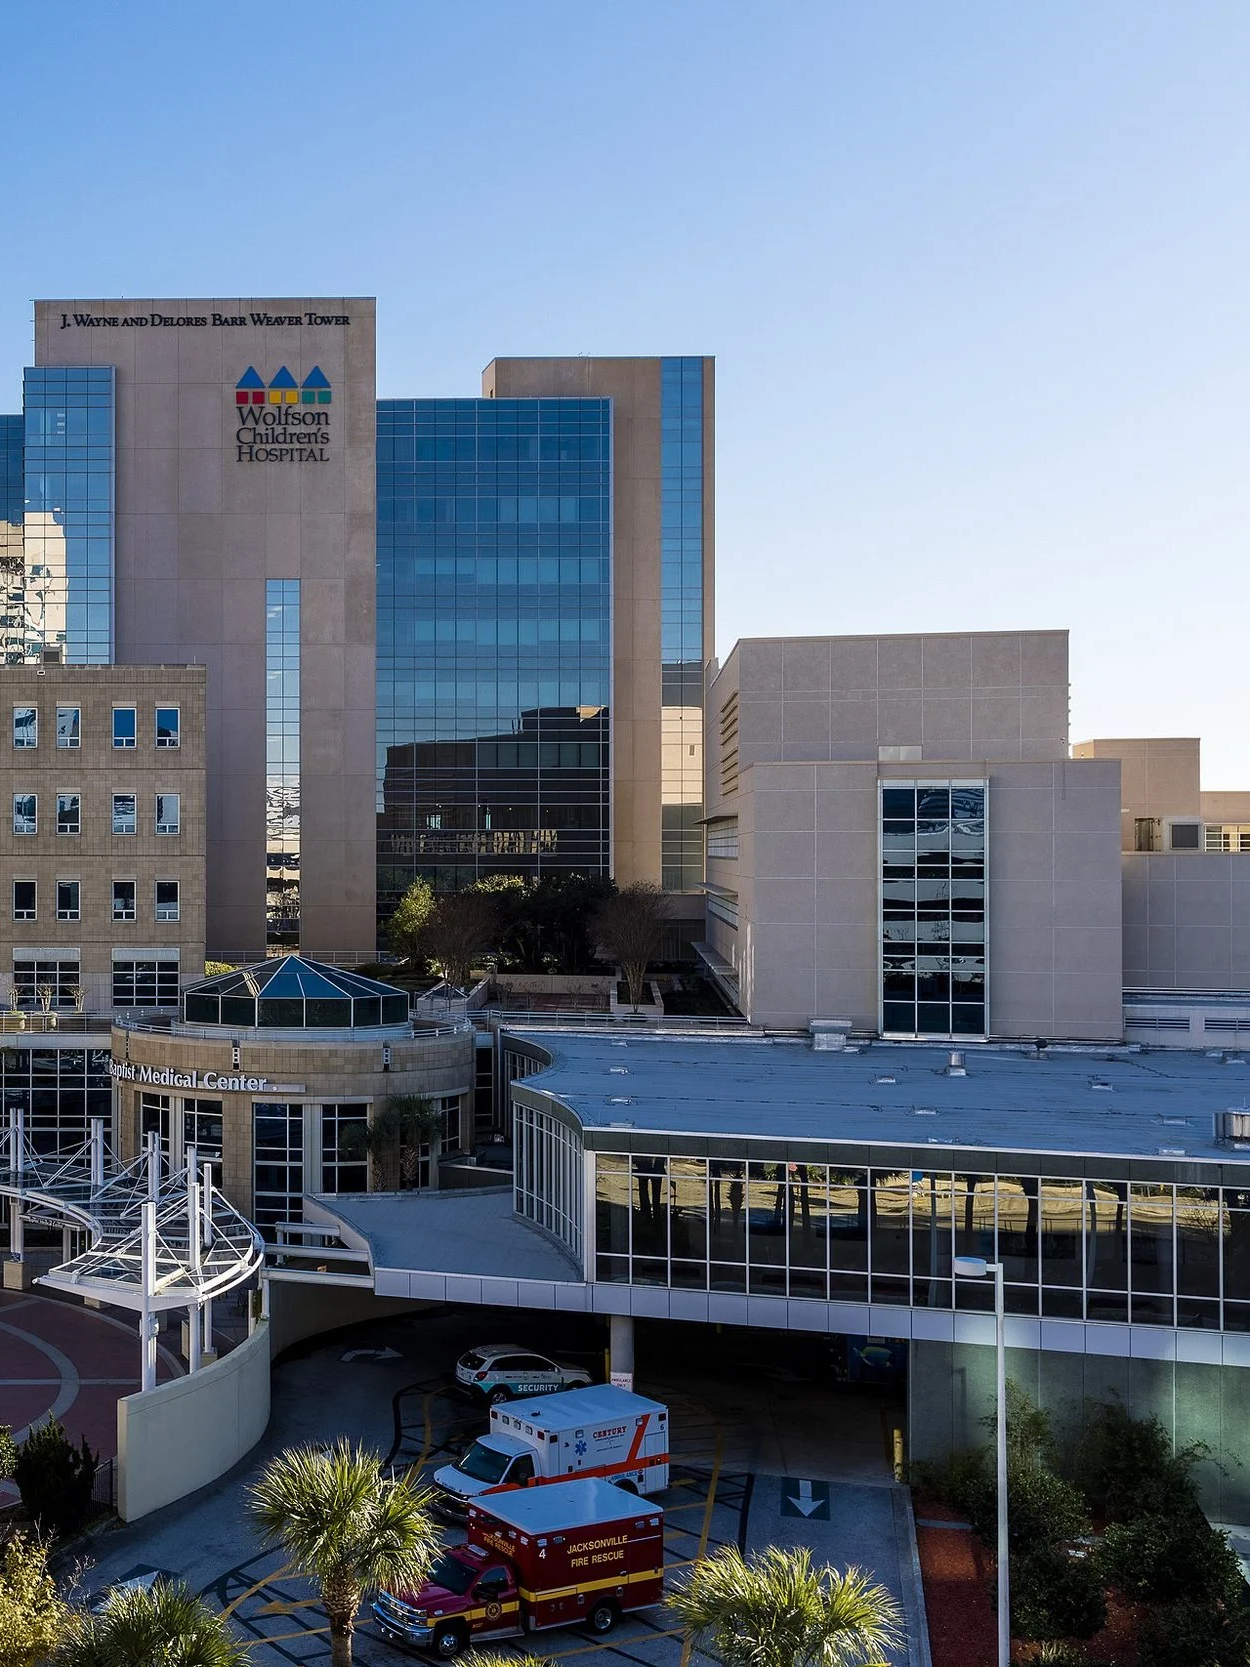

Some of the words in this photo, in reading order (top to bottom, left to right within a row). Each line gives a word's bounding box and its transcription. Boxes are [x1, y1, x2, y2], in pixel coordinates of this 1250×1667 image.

[60, 314, 71, 329] J.
[236, 405, 330, 426] Wolfson
[236, 427, 330, 445] Children's
[236, 445, 330, 462] HOSPITAL
[109, 1059, 136, 1081] Baptist
[139, 1065, 197, 1088] Medical
[203, 1071, 268, 1091] Center
[518, 1384, 559, 1392] SECURITY
[593, 1426, 627, 1439] CENTURY
[567, 1535, 628, 1555] JACKSONVILLE
[539, 1549, 546, 1559] 4
[571, 1556, 589, 1568] FIRE
[591, 1550, 624, 1564] RESCUE
